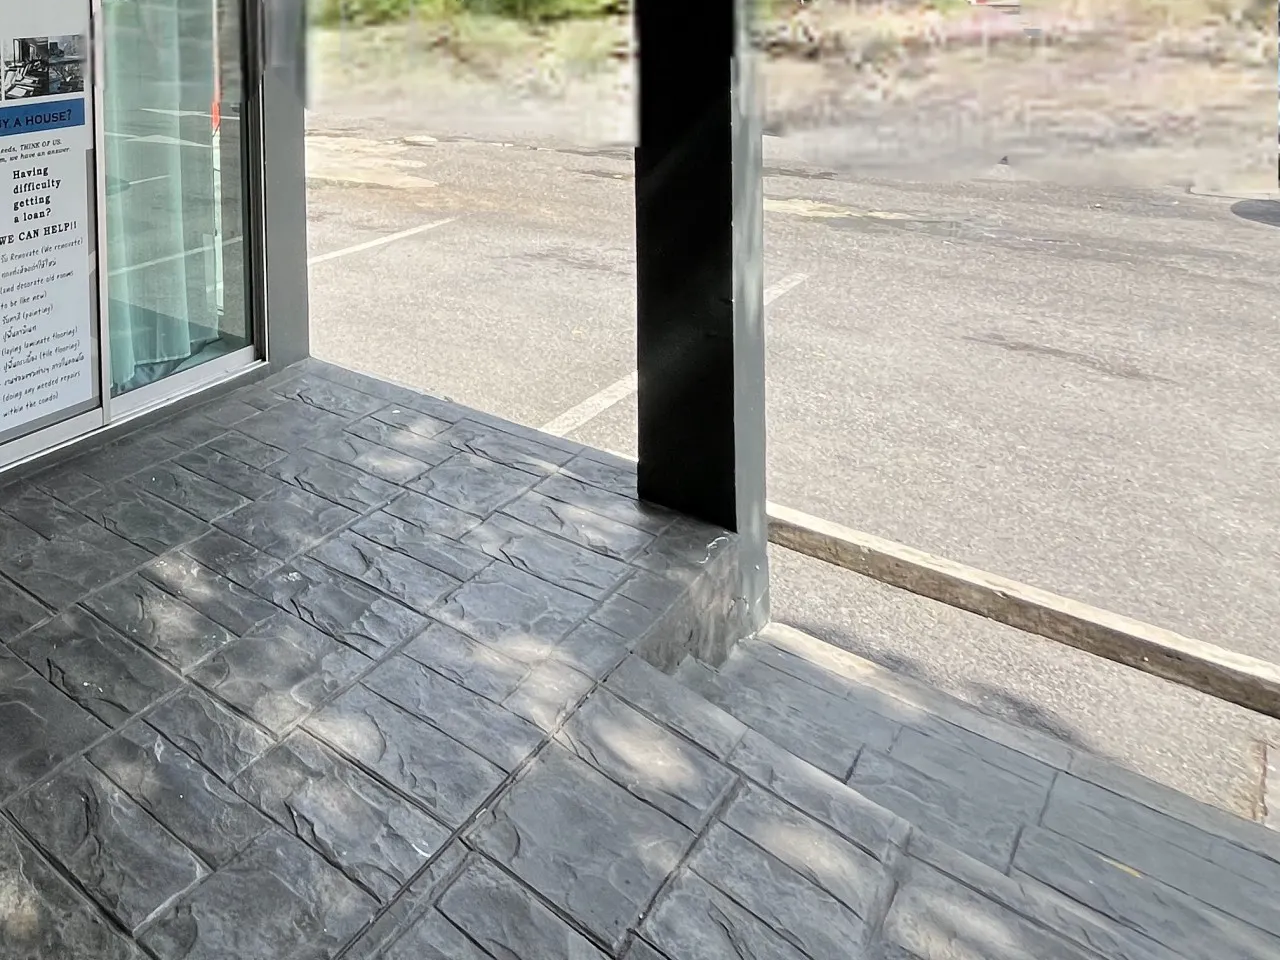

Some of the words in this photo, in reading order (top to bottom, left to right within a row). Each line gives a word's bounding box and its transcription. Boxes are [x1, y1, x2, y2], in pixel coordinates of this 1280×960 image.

[13, 117, 22, 128] A
[25, 108, 72, 126] HOUSE?
[20, 141, 40, 152] THINK
[9, 155, 19, 163] we
[21, 151, 35, 160] have
[37, 150, 46, 158] an
[12, 166, 49, 180] Having
[13, 179, 62, 195] difficulty
[13, 195, 51, 211] getting
[14, 216, 20, 224] a
[23, 207, 51, 221] loan?
[18, 228, 40, 242] CAN
[16, 277, 44, 291] decorate
